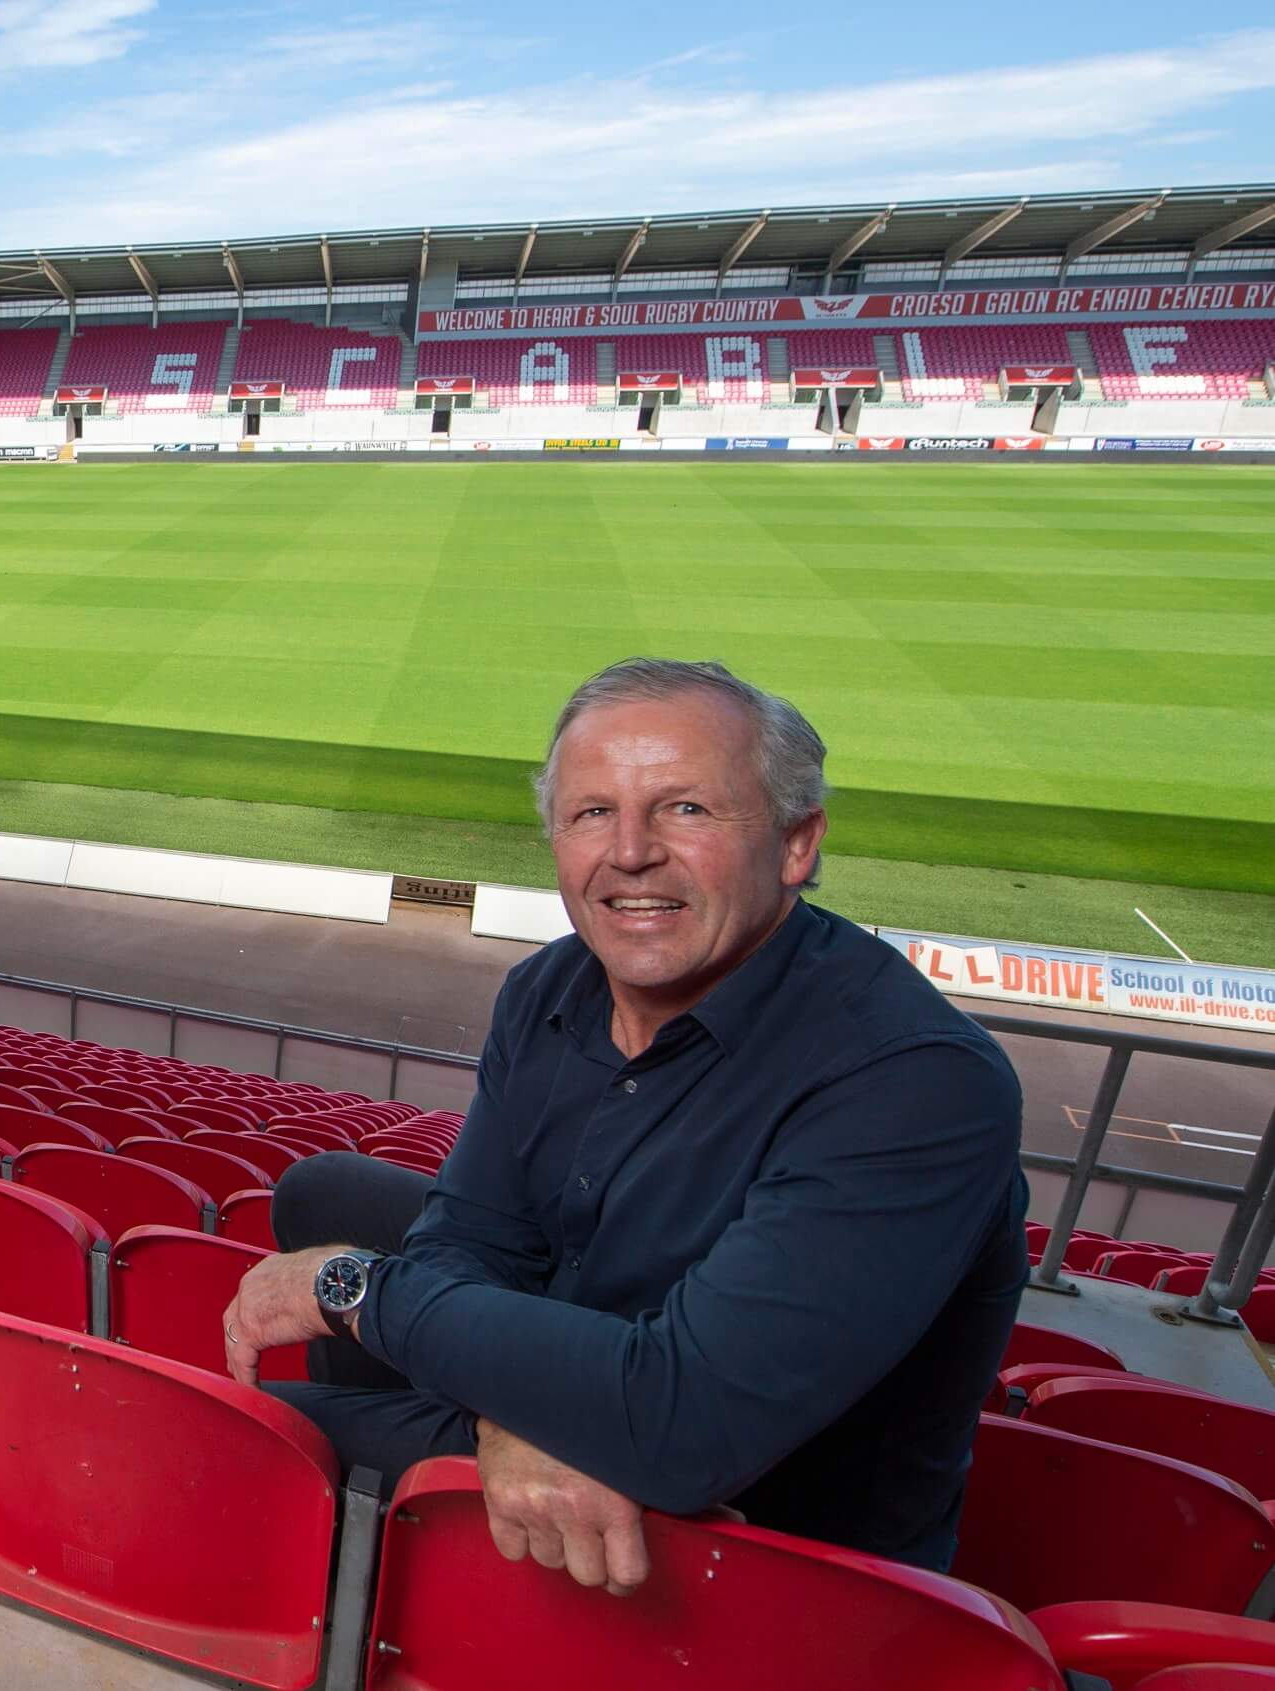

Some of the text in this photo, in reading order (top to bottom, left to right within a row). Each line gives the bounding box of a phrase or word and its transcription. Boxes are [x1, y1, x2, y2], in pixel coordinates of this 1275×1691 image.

[436, 300, 779, 331] WELCOME TO HEART & SOUL RUGBY COUNTRY
[890, 293, 965, 317] CROESO
[971, 293, 979, 314] I
[985, 291, 1050, 314] GALON
[1055, 290, 1081, 312] AC
[1089, 288, 1152, 312] ENAID
[1157, 285, 1235, 309] CENEDL
[1001, 953, 1106, 1004] DRIVE
[1111, 967, 1184, 994] School
[1192, 976, 1214, 997] of
